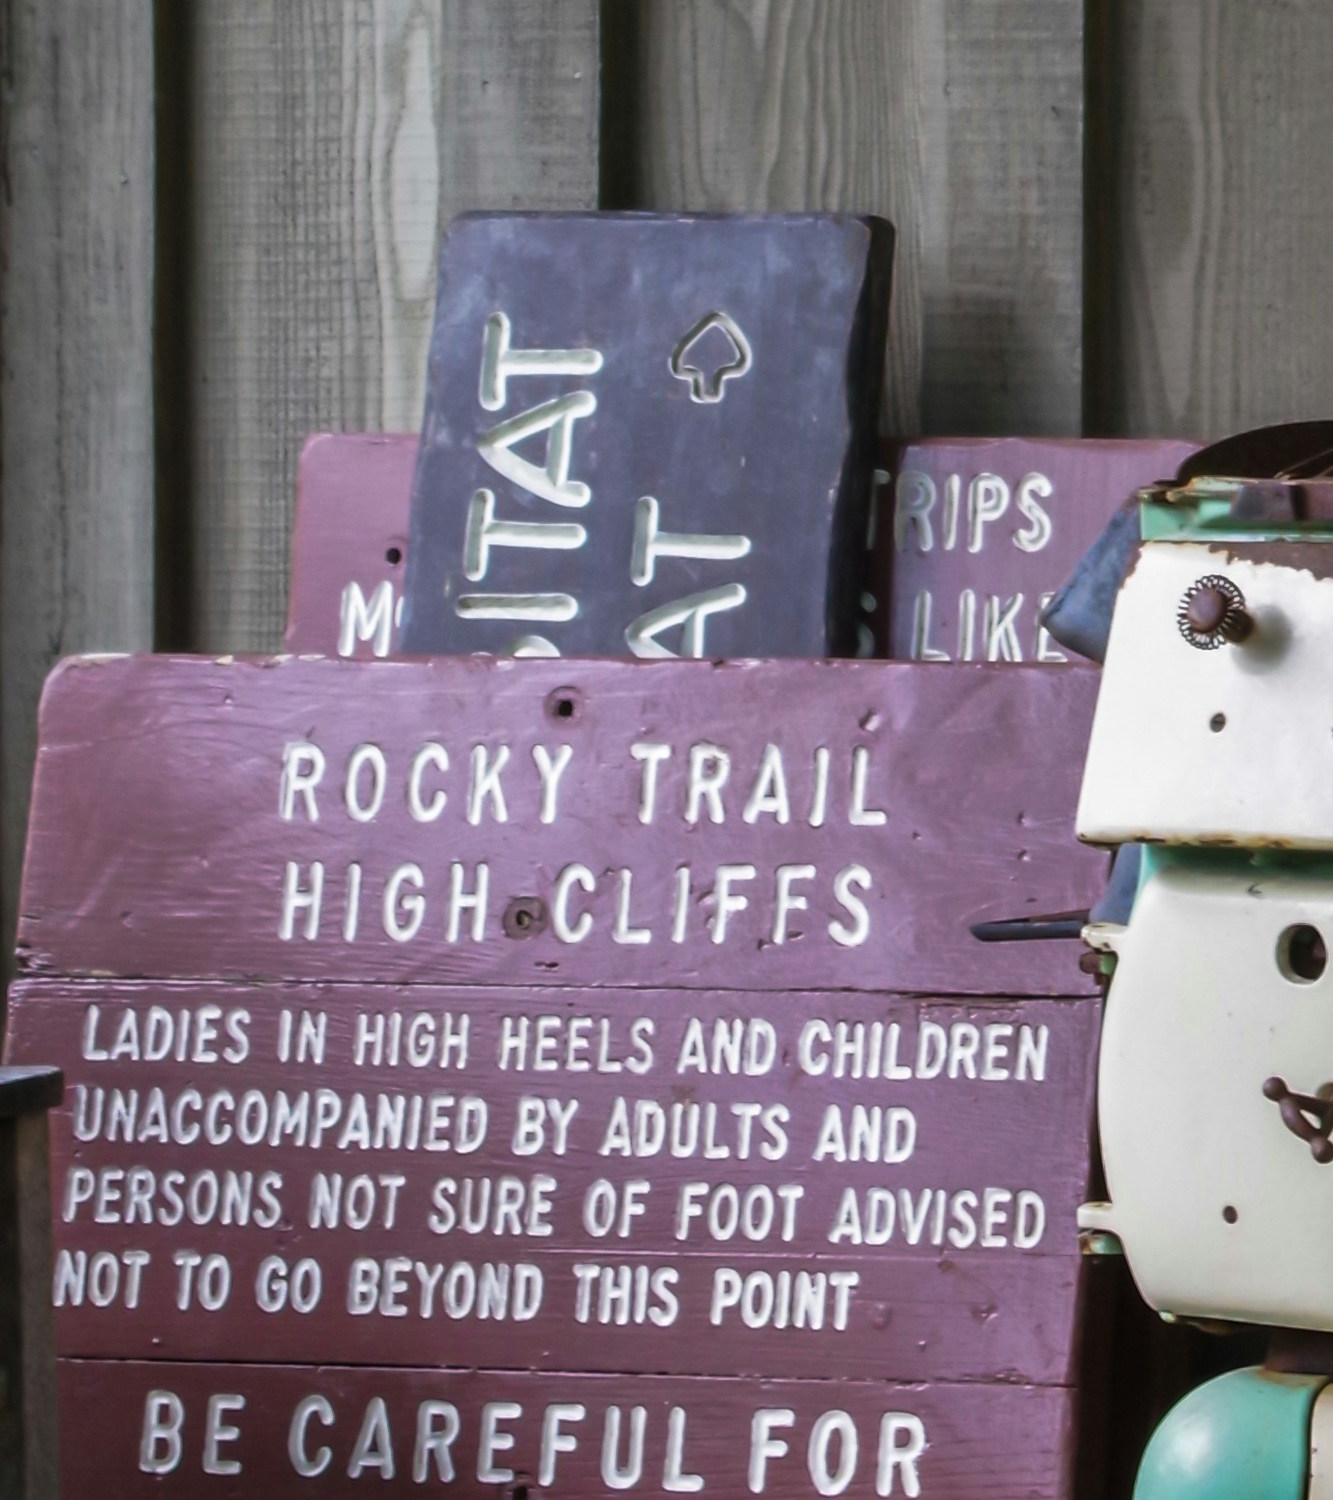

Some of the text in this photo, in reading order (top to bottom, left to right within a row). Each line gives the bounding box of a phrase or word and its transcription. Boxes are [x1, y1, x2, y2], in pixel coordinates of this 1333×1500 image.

[456, 311, 603, 658] ITAT
[279, 742, 887, 827] ROCKY TRAIL
[279, 862, 873, 947] HIGH CLIFFS
[82, 1005, 1048, 1082] LADIES IN HIGH HEELS AND CHILDREN
[73, 1085, 915, 1162] UNACCOMPANIED BY ADULTS AND
[62, 1166, 1045, 1249] PERSONS NOT SURE OF FOOT ADVISED
[53, 1250, 859, 1331] NOT TO GO BEYOND THIS POINT
[138, 1389, 930, 1498] BE CAREFUL FOR
